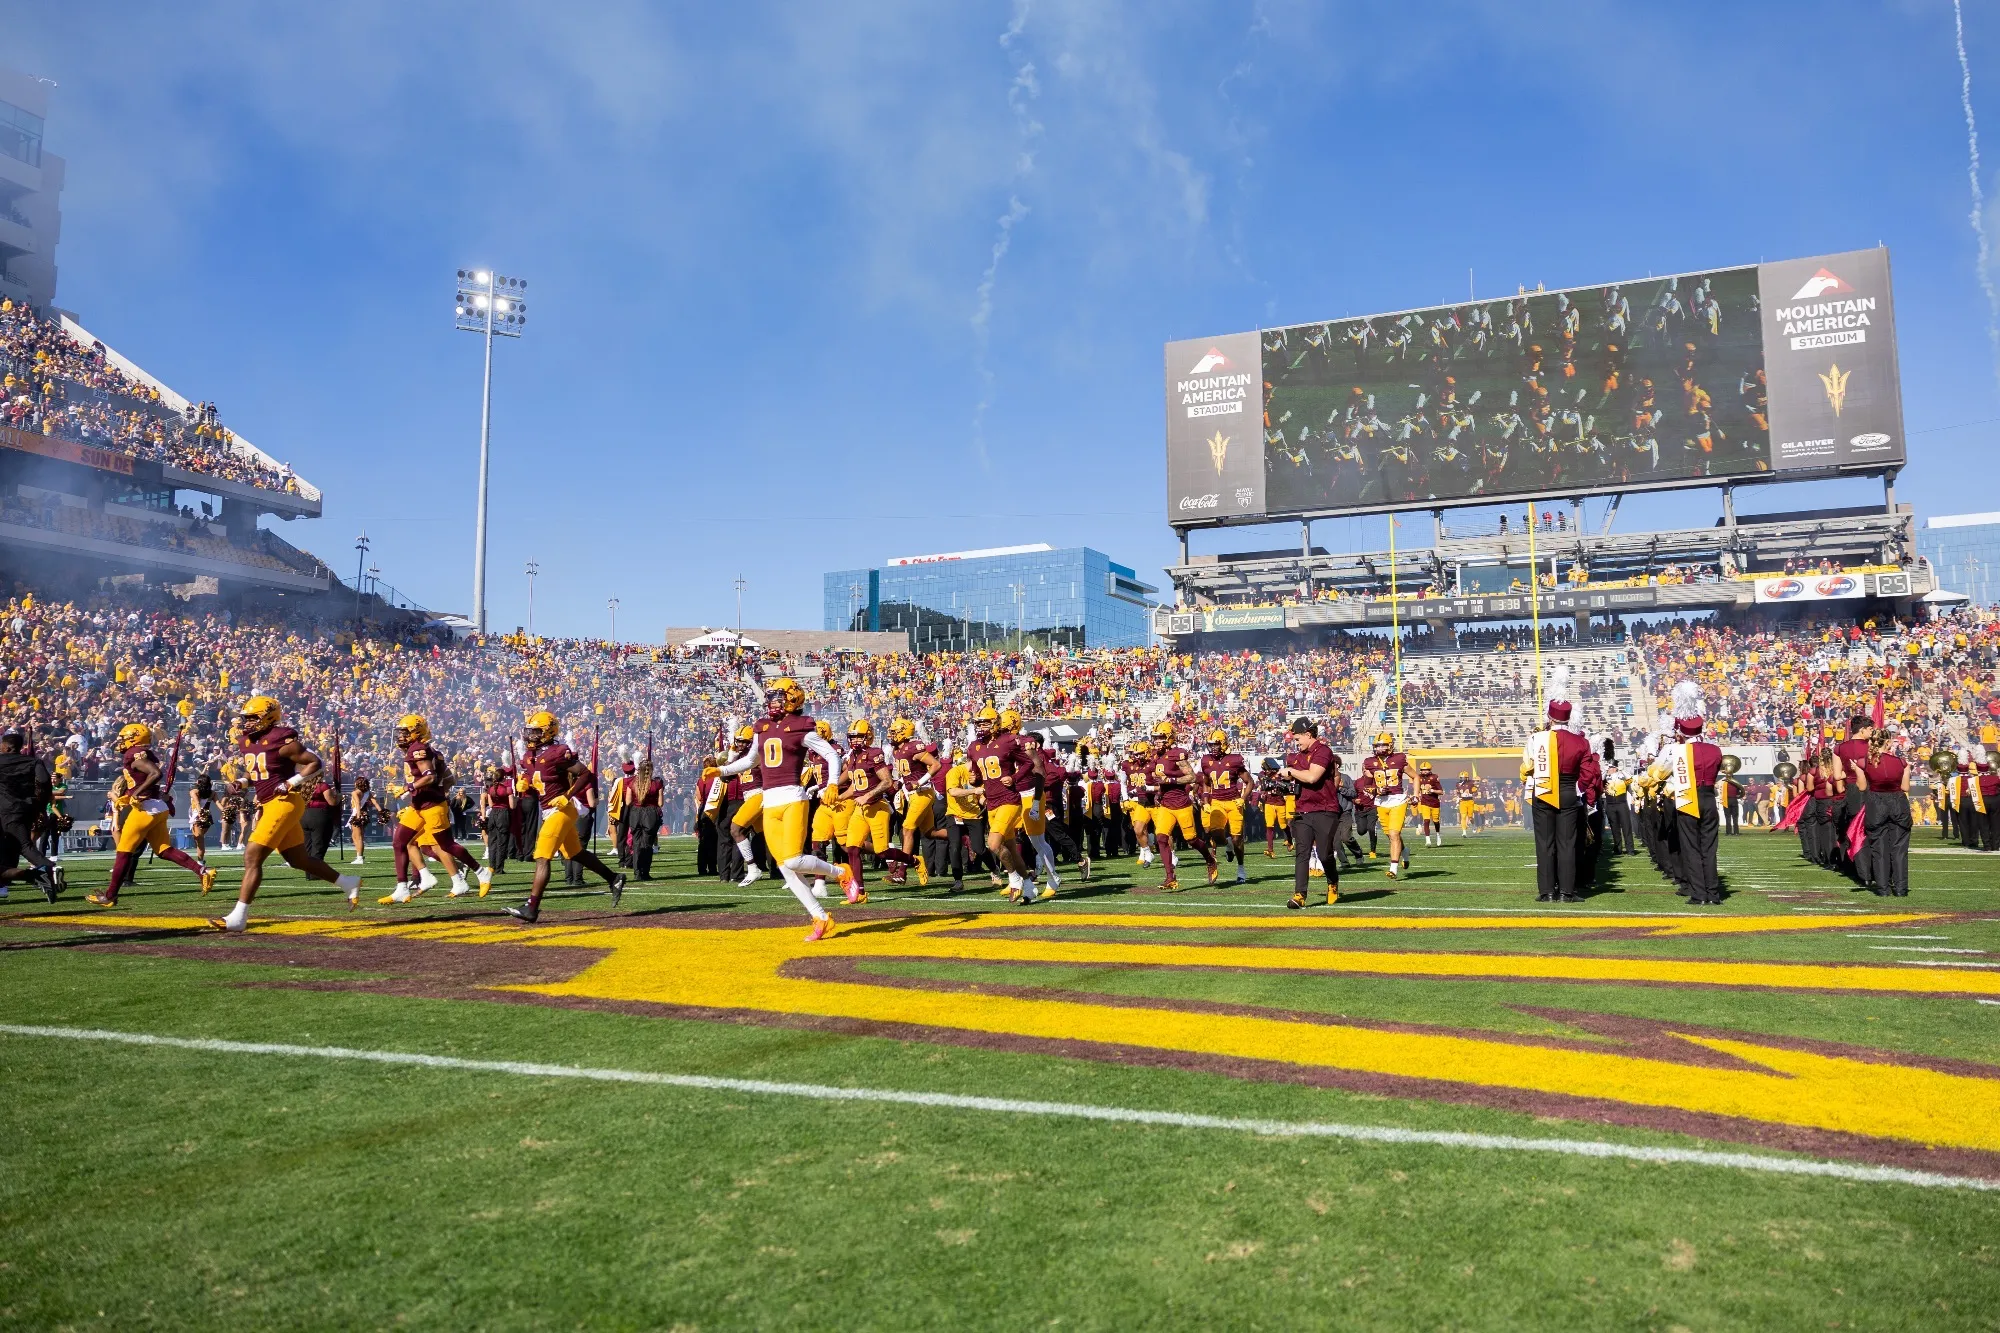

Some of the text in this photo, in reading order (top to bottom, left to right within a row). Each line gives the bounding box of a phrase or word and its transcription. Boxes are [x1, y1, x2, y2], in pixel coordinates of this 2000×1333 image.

[1776, 297, 1876, 321] MOUNTAIN
[1782, 313, 1871, 335] AMERICA
[1800, 333, 1857, 347] STADIUM
[1177, 374, 1251, 392] MOUNTAIN
[94, 389, 108, 399] 309
[1182, 387, 1247, 404] AMERICA
[1193, 403, 1238, 416] STADIUM
[1781, 438, 1834, 449] GILA RIVER
[1858, 436, 1882, 445] Ford
[81, 448, 133, 473] SUN DE
[1180, 493, 1220, 510] Coca-Cola
[1767, 584, 1779, 594] 4
[1819, 581, 1831, 591] 4
[1881, 576, 1906, 594] 25
[1499, 599, 1520, 611] 3:38
[1172, 617, 1190, 631] 25
[1215, 611, 1282, 626] Someburros
[764, 738, 783, 768] 0
[1538, 745, 1547, 772] ASU
[1740, 757, 1757, 765] TY
[244, 752, 269, 781] 21
[977, 756, 1002, 780] 18
[1676, 757, 1687, 785] ASU
[1210, 770, 1231, 790] 14
